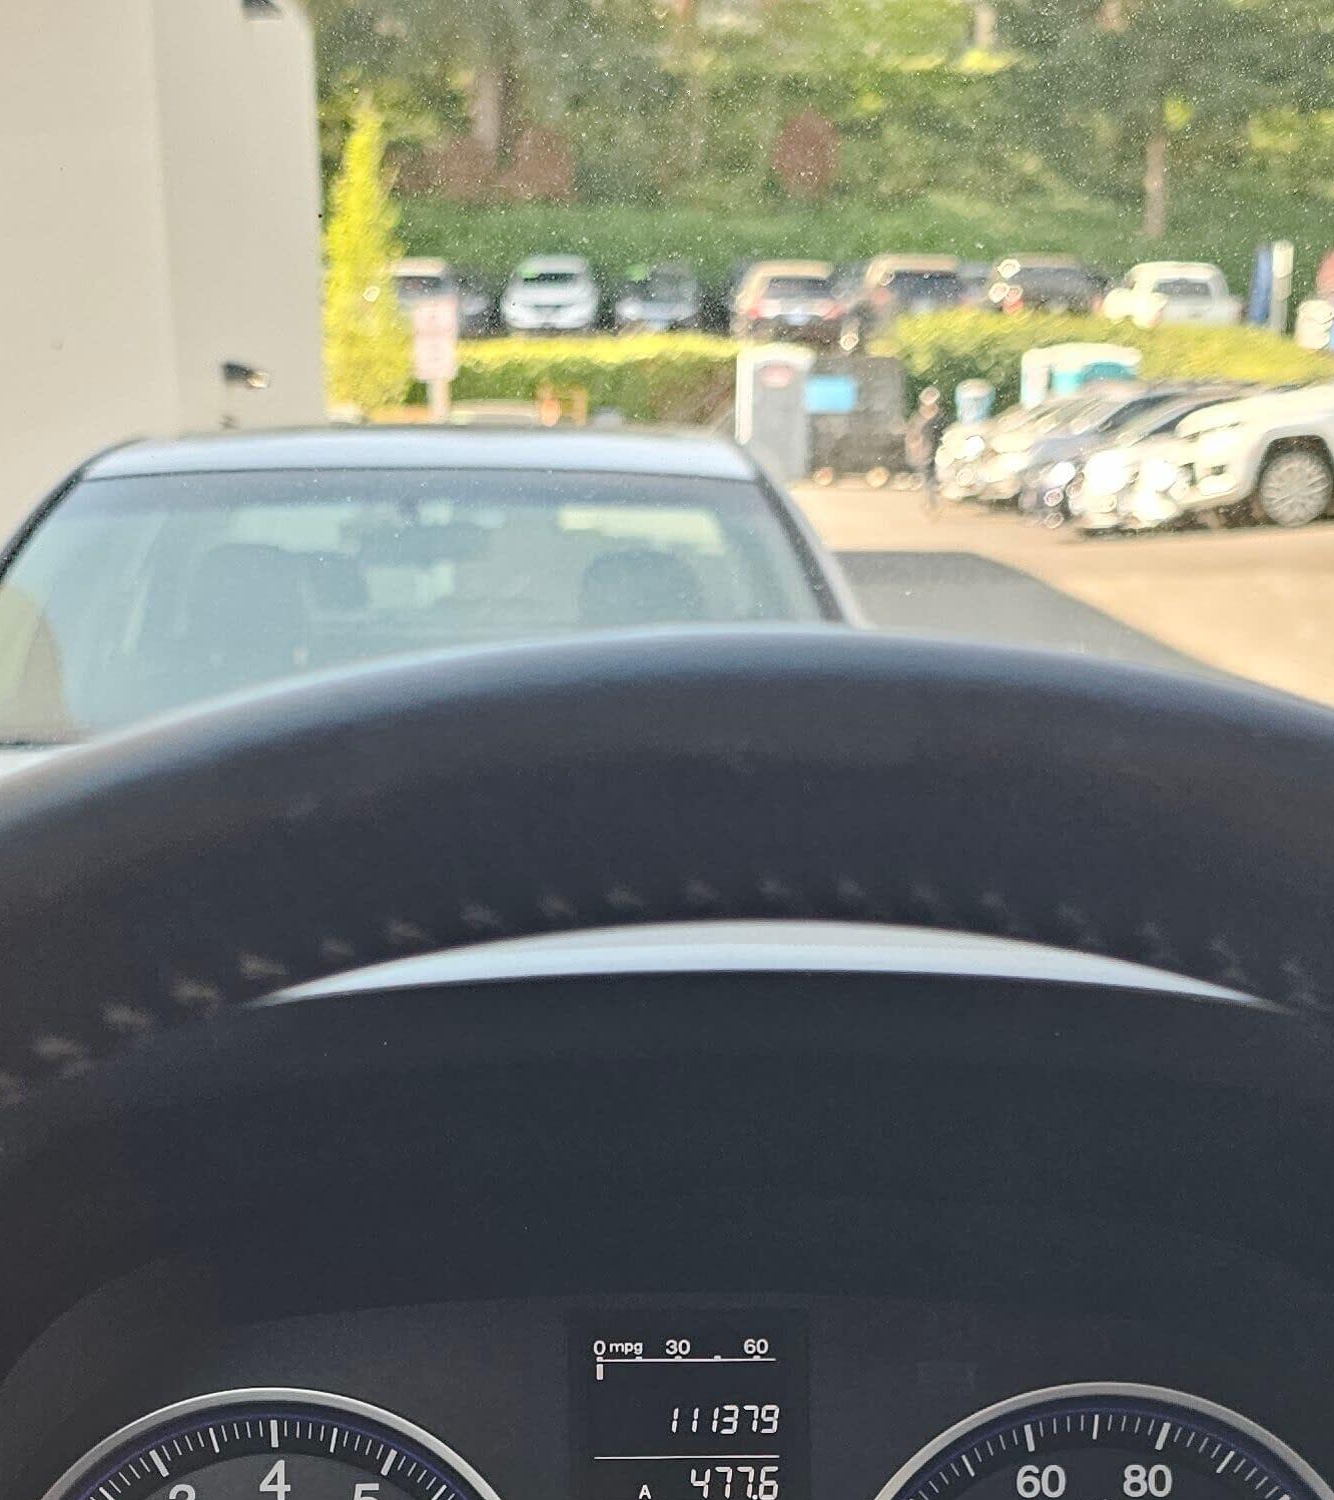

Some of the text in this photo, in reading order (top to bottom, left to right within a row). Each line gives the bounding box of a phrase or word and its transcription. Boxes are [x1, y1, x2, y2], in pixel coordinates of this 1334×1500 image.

[594, 1339, 768, 1355] 0 mpg 30 60
[672, 1405, 779, 1434] 111379
[260, 1460, 291, 1500] 4
[639, 1485, 651, 1499] A
[1017, 1465, 1066, 1498] 60
[1123, 1465, 1172, 1497] 80
